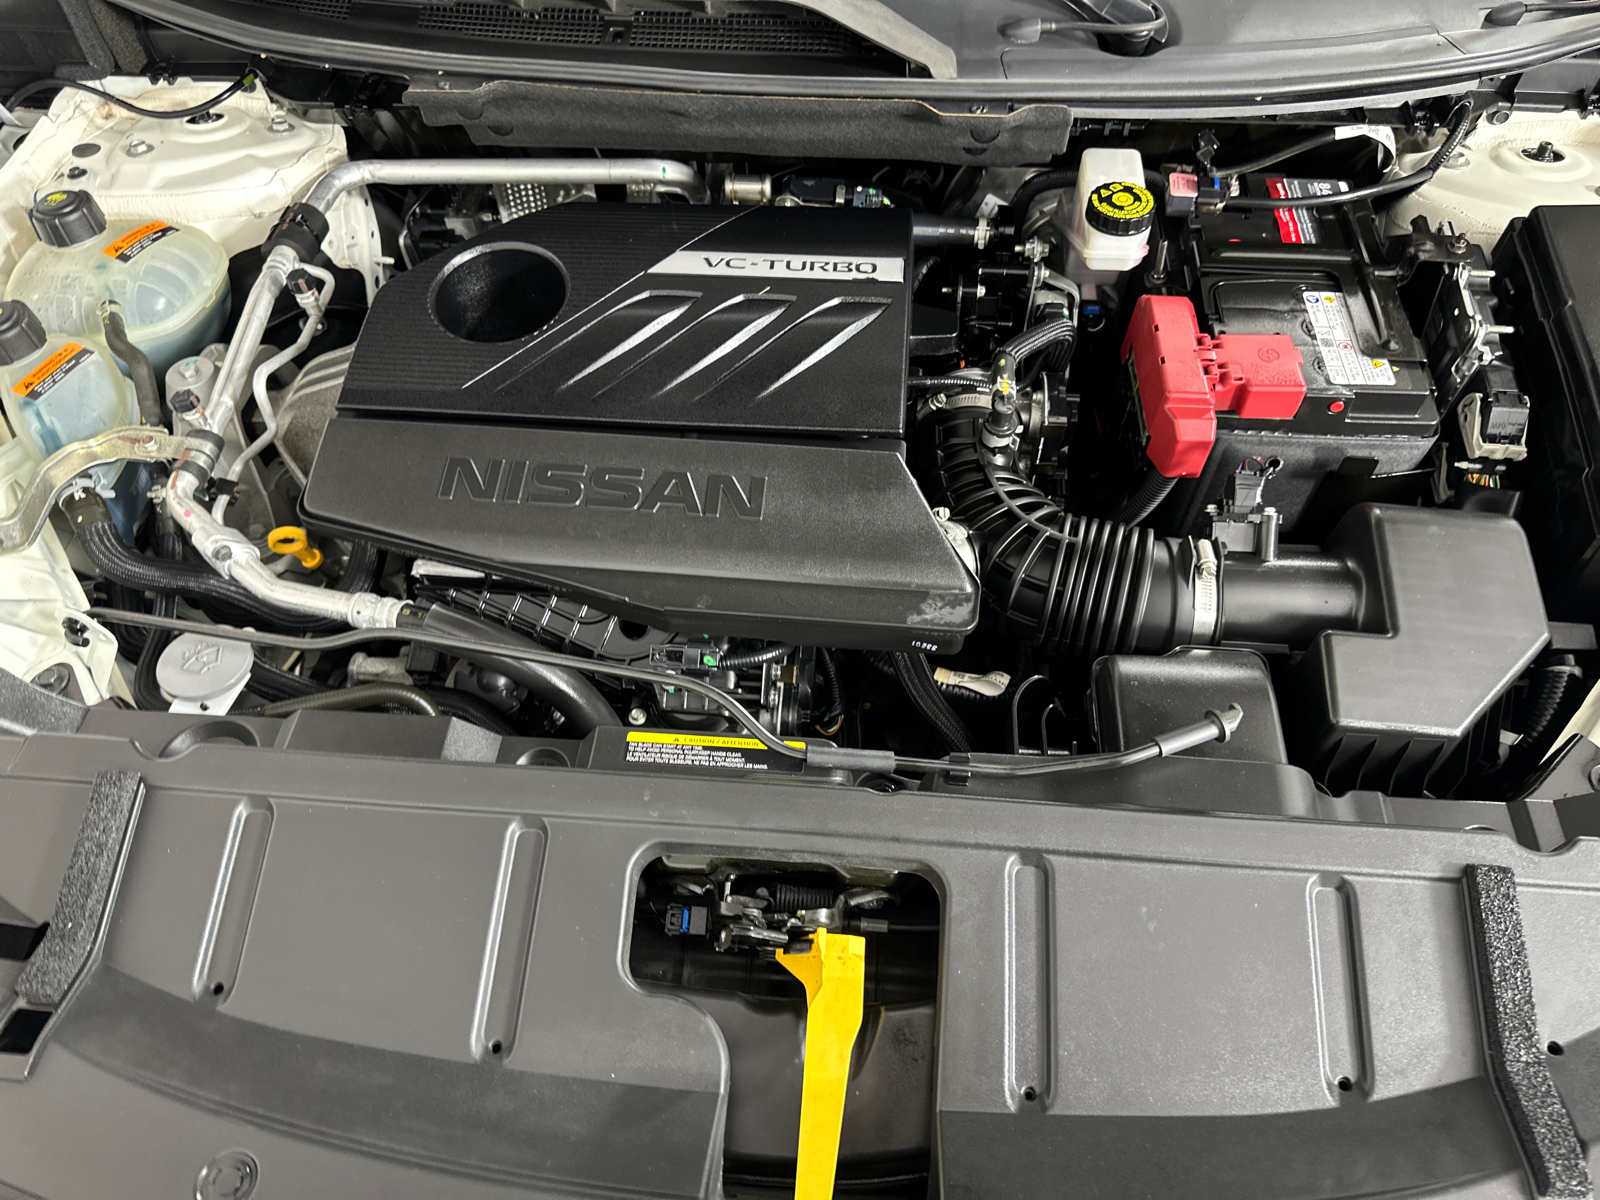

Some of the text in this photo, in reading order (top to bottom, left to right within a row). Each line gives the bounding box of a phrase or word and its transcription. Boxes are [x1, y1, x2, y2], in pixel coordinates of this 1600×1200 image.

[703, 256, 878, 275] VC-TURBO
[438, 457, 767, 520] NISSAN
[684, 737, 715, 745] CAUTION
[721, 739, 760, 748] ATTENTION
